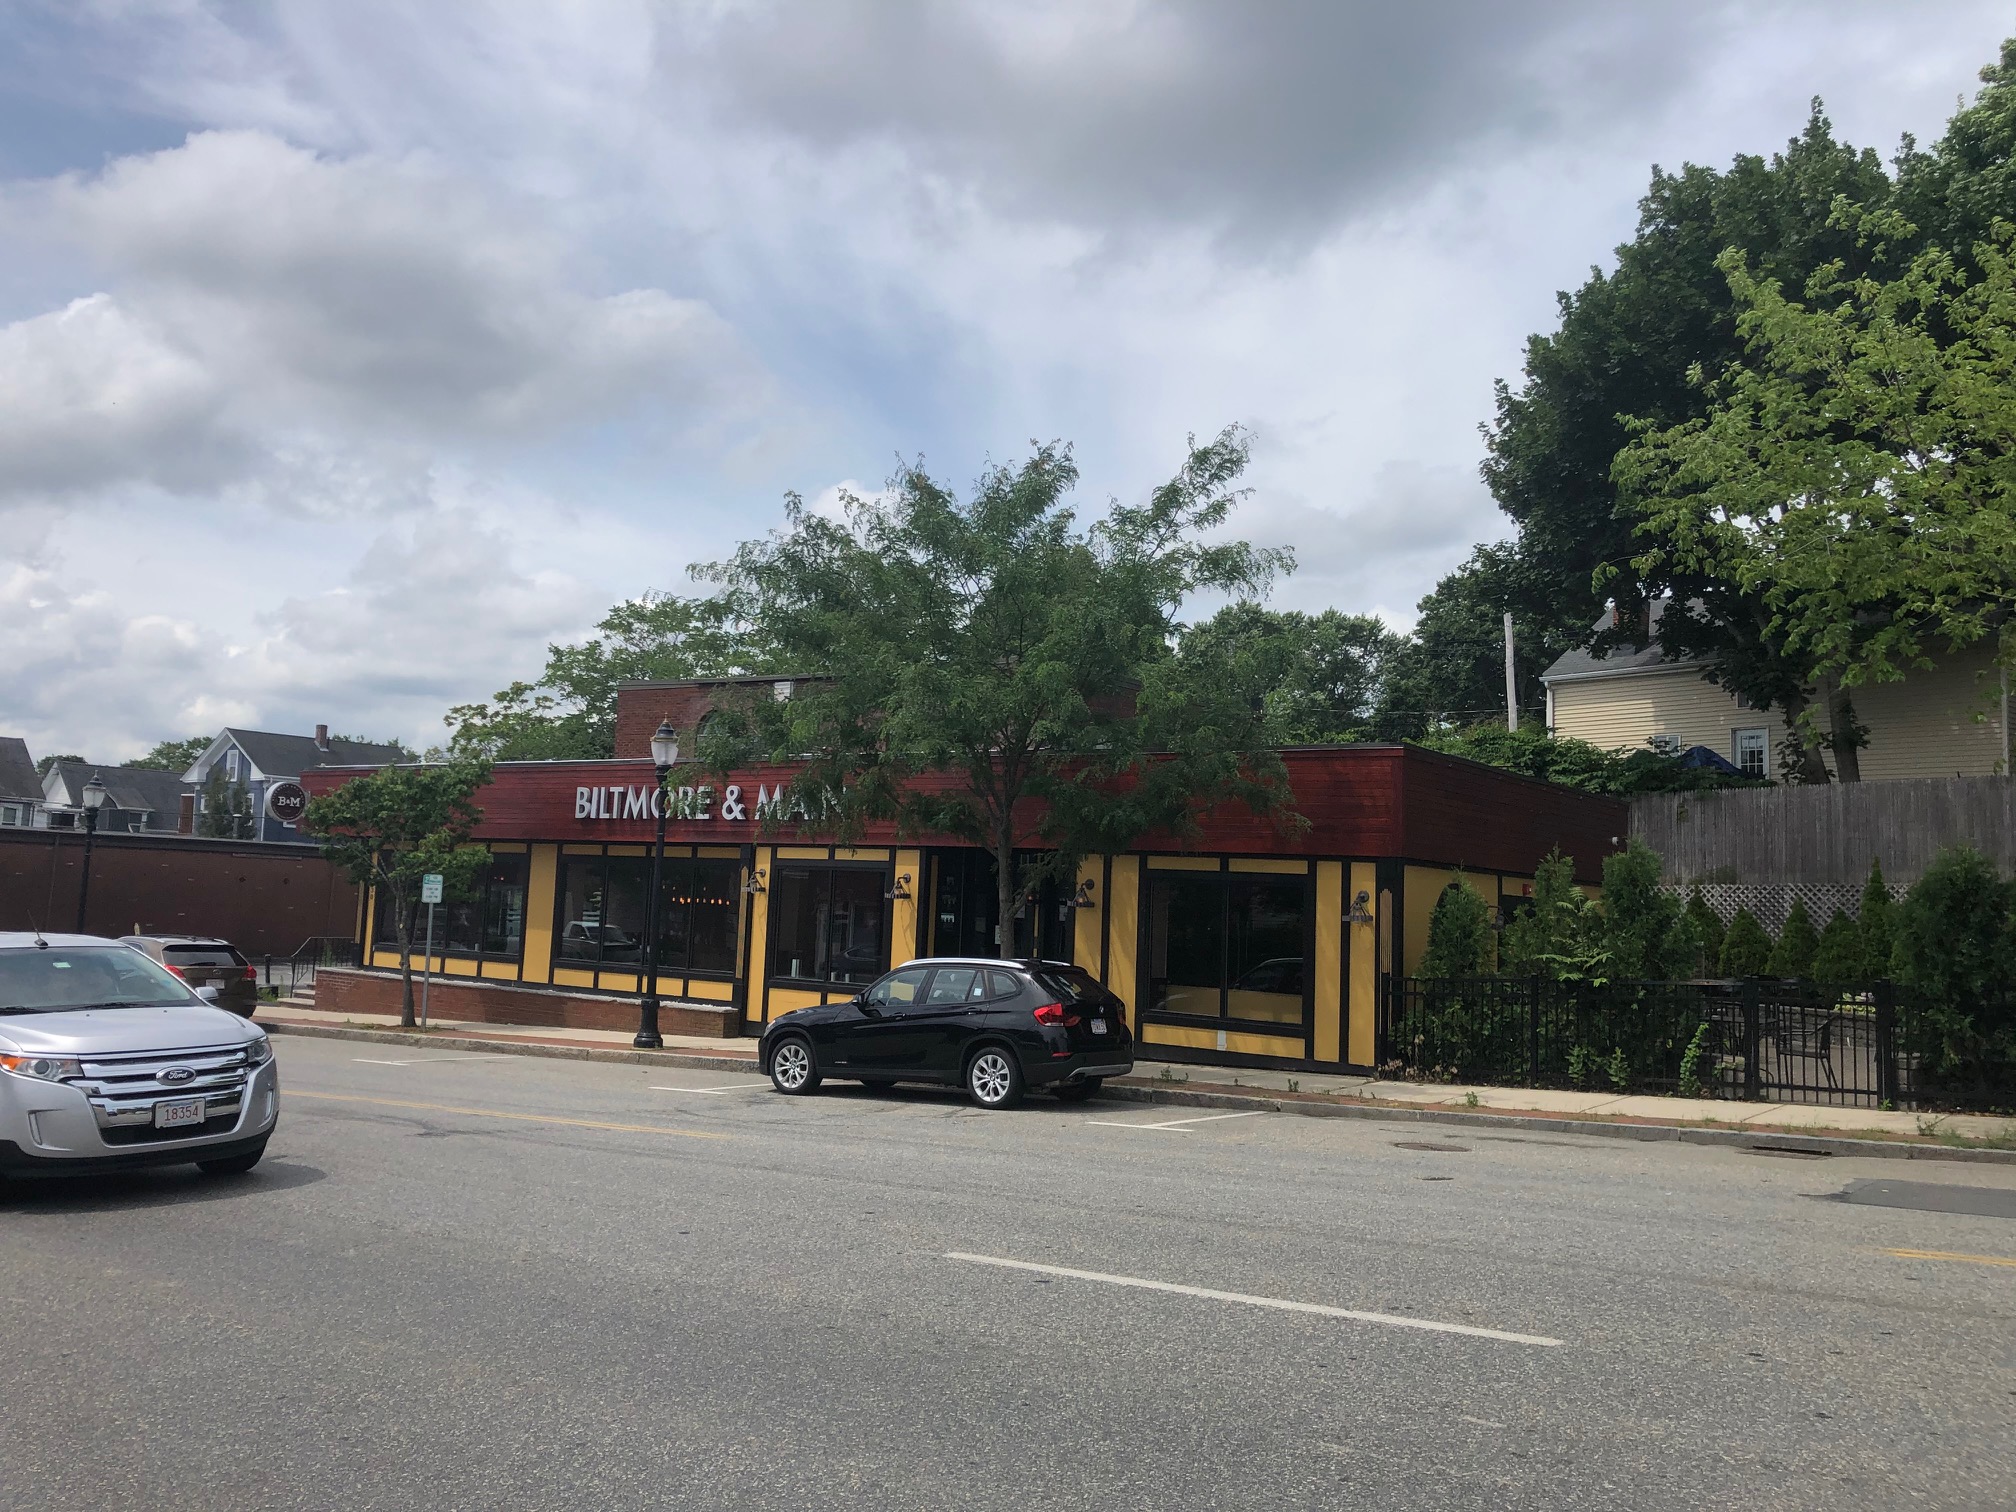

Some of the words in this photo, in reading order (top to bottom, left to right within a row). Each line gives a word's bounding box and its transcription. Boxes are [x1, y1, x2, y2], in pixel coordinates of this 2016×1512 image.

[721, 785, 746, 820] &
[754, 783, 847, 821] MAN
[168, 1070, 188, 1079] Ford
[164, 1105, 199, 1121] 18354
